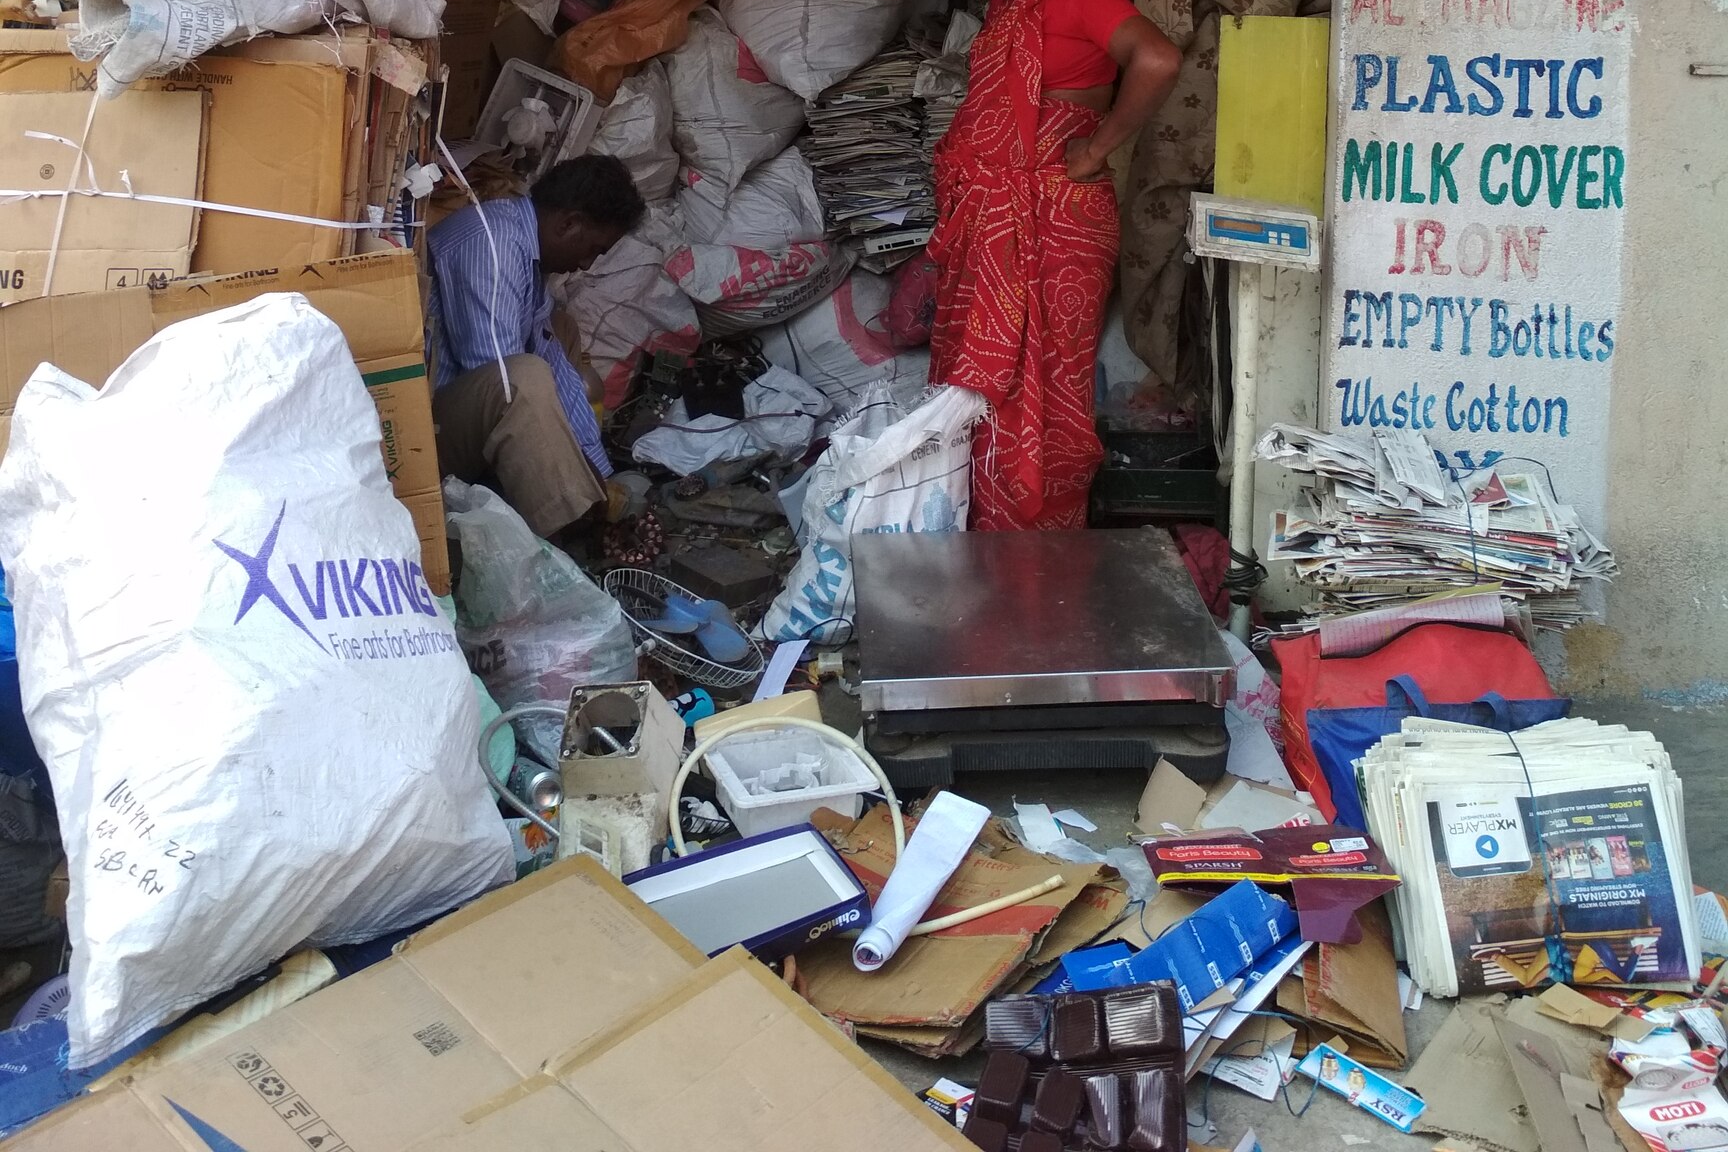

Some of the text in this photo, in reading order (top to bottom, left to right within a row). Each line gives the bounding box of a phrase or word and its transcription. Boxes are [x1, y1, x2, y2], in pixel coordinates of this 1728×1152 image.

[1352, 53, 1603, 119] PLASTIC
[1342, 138, 1626, 209] MILK COVER
[1388, 217, 1548, 282] IRON
[1338, 289, 1614, 362] EMPTY Bottles
[1335, 377, 1570, 438] Waste Cotton
[287, 557, 438, 621] VIKING
[328, 633, 361, 660] Fine
[386, 629, 404, 657] for
[1203, 848, 1251, 858] Beauty
[1568, 889, 1628, 903] ORIGINALS
[1655, 1101, 1702, 1121] MOTI
